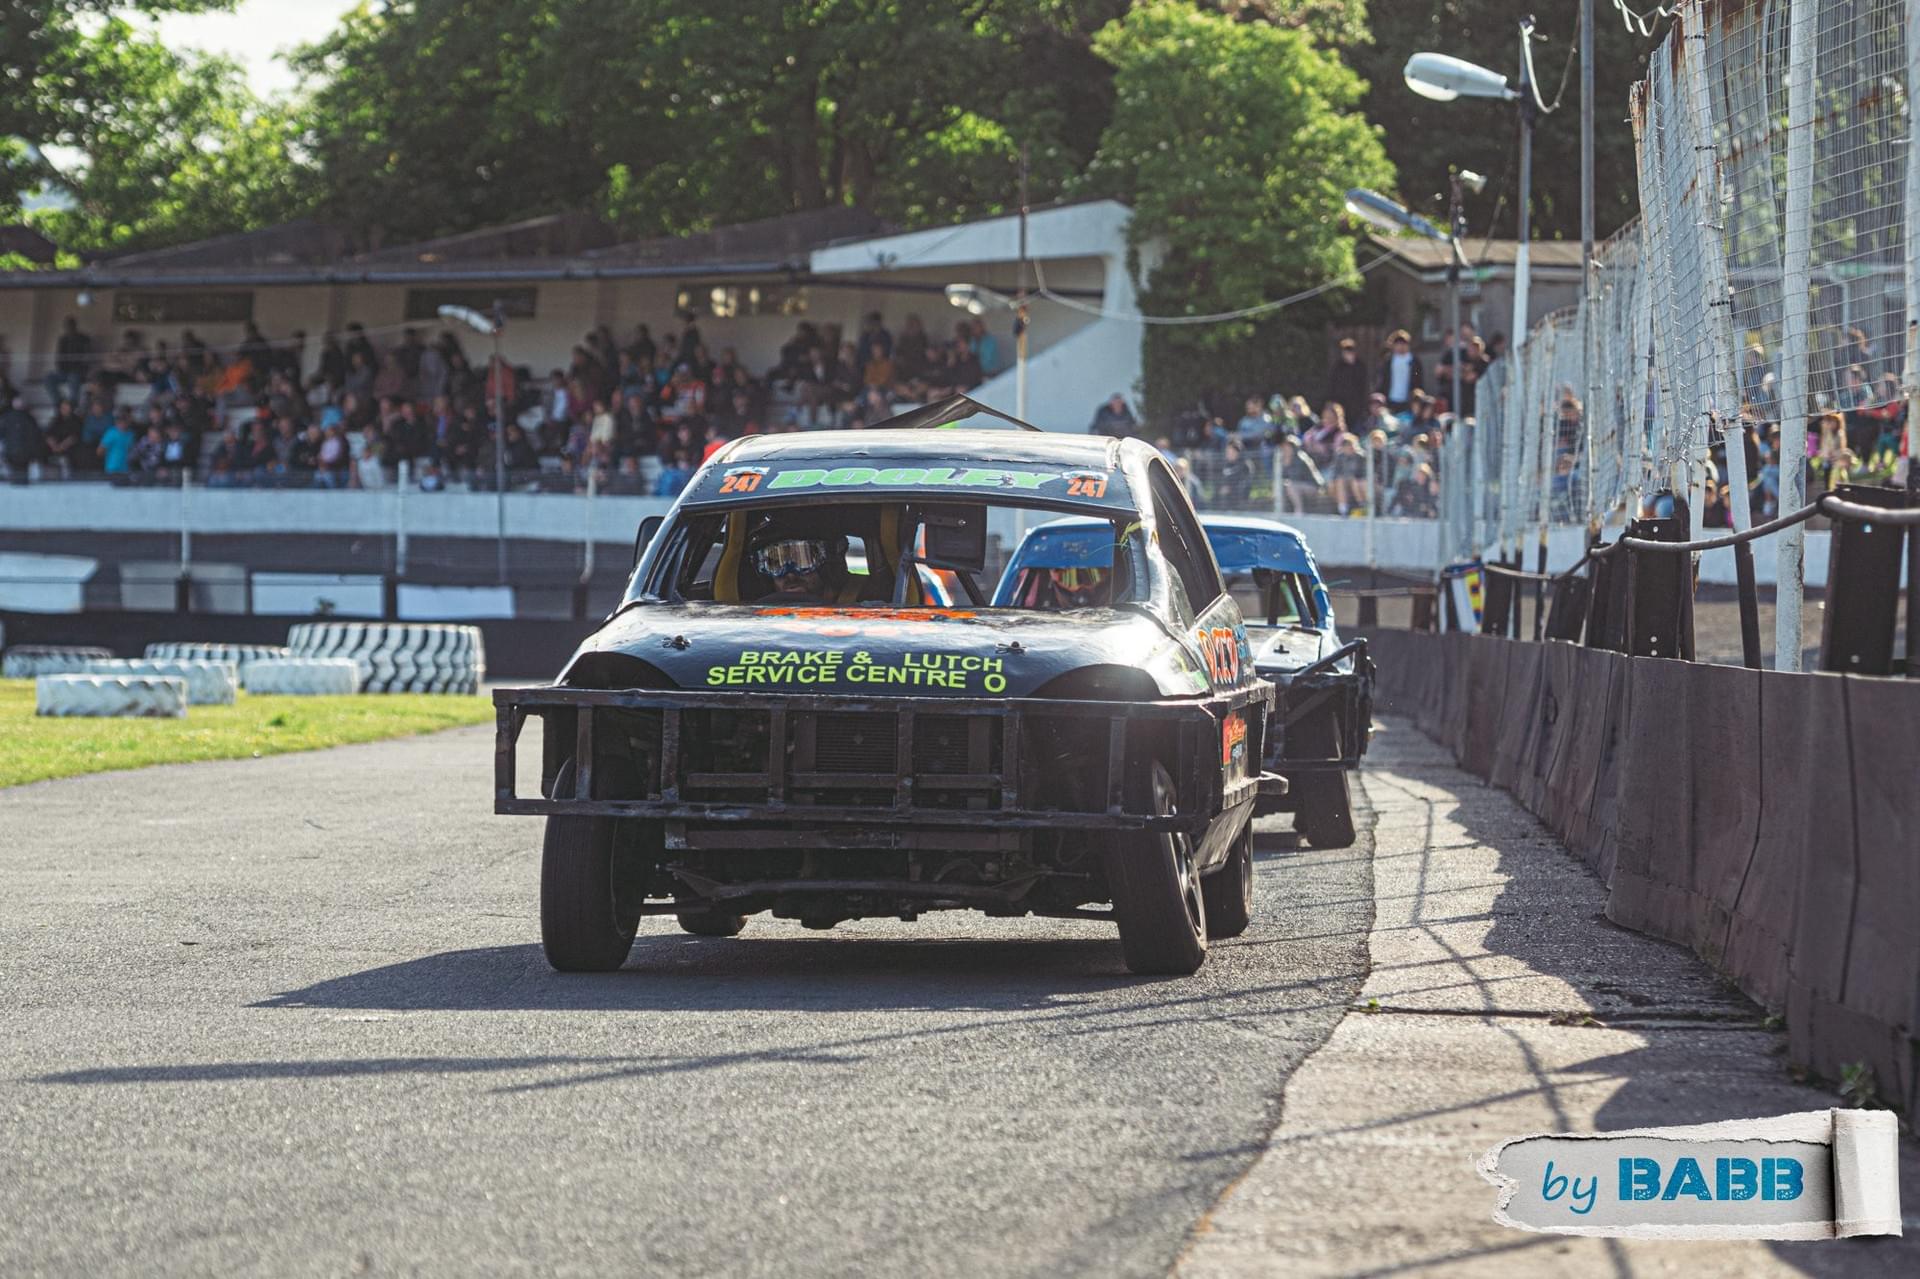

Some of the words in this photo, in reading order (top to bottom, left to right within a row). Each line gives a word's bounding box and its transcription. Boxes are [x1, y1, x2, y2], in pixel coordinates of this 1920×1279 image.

[719, 474, 762, 493] 247
[767, 468, 1061, 489] DOOLEY
[1067, 478, 1108, 498] 247
[739, 651, 844, 665] BRAKE
[852, 651, 873, 664] &
[904, 653, 1002, 673] LUTCH
[706, 665, 837, 685] SERVICE
[846, 666, 967, 688] CENTRE
